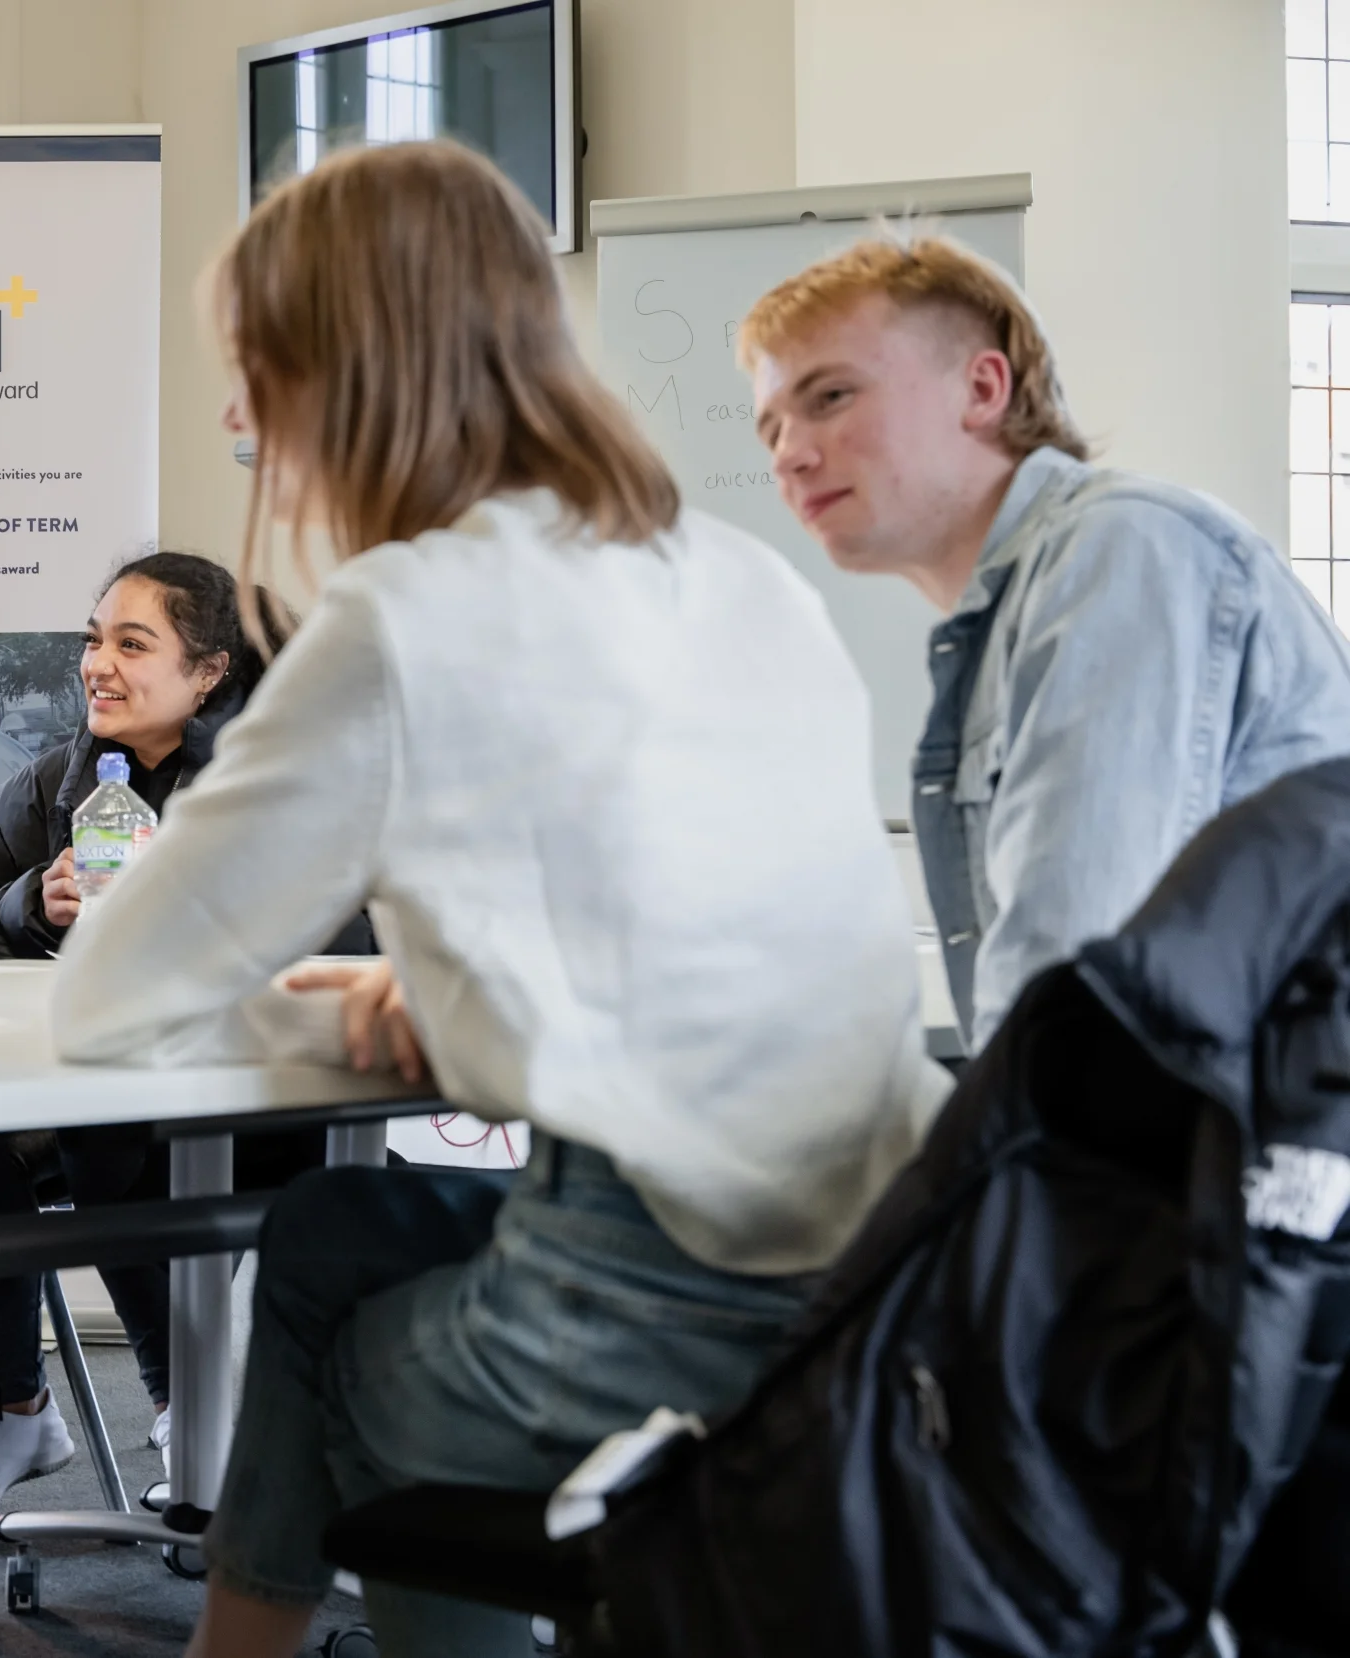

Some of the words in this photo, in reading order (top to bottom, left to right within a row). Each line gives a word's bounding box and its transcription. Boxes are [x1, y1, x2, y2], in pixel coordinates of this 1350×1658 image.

[39, 471, 61, 484] you
[64, 471, 83, 480] are
[26, 517, 79, 532] TERM
